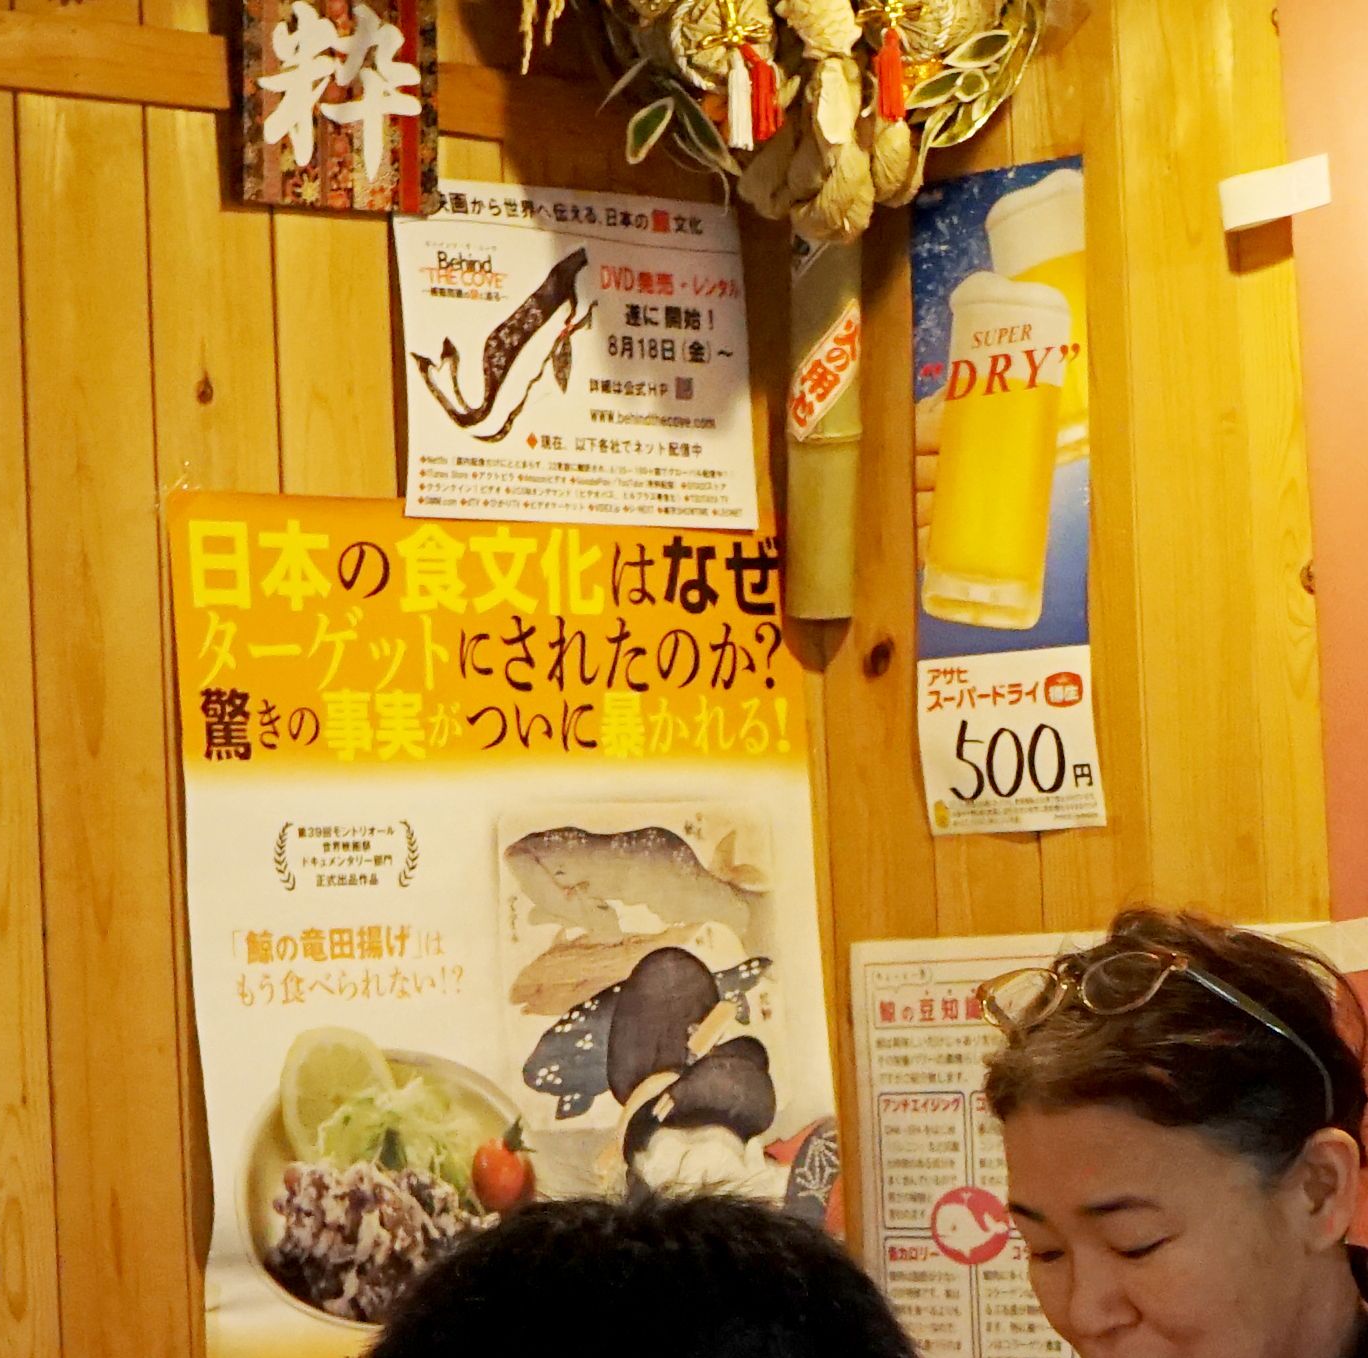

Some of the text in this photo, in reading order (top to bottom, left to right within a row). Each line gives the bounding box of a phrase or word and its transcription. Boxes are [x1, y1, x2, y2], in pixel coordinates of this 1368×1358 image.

[437, 250, 493, 273] Behind
[971, 323, 1032, 350] SUPER
[188, 519, 780, 617] 日本の食文化はなぜ
[198, 606, 782, 692] ターゲットにされたのか？
[927, 667, 969, 687] アサヒ
[926, 680, 1039, 713] スーパードライ
[199, 686, 792, 762] 驚きの事実がついに暴かれる！
[232, 924, 446, 965] 「鯨の竜田揚げ」は
